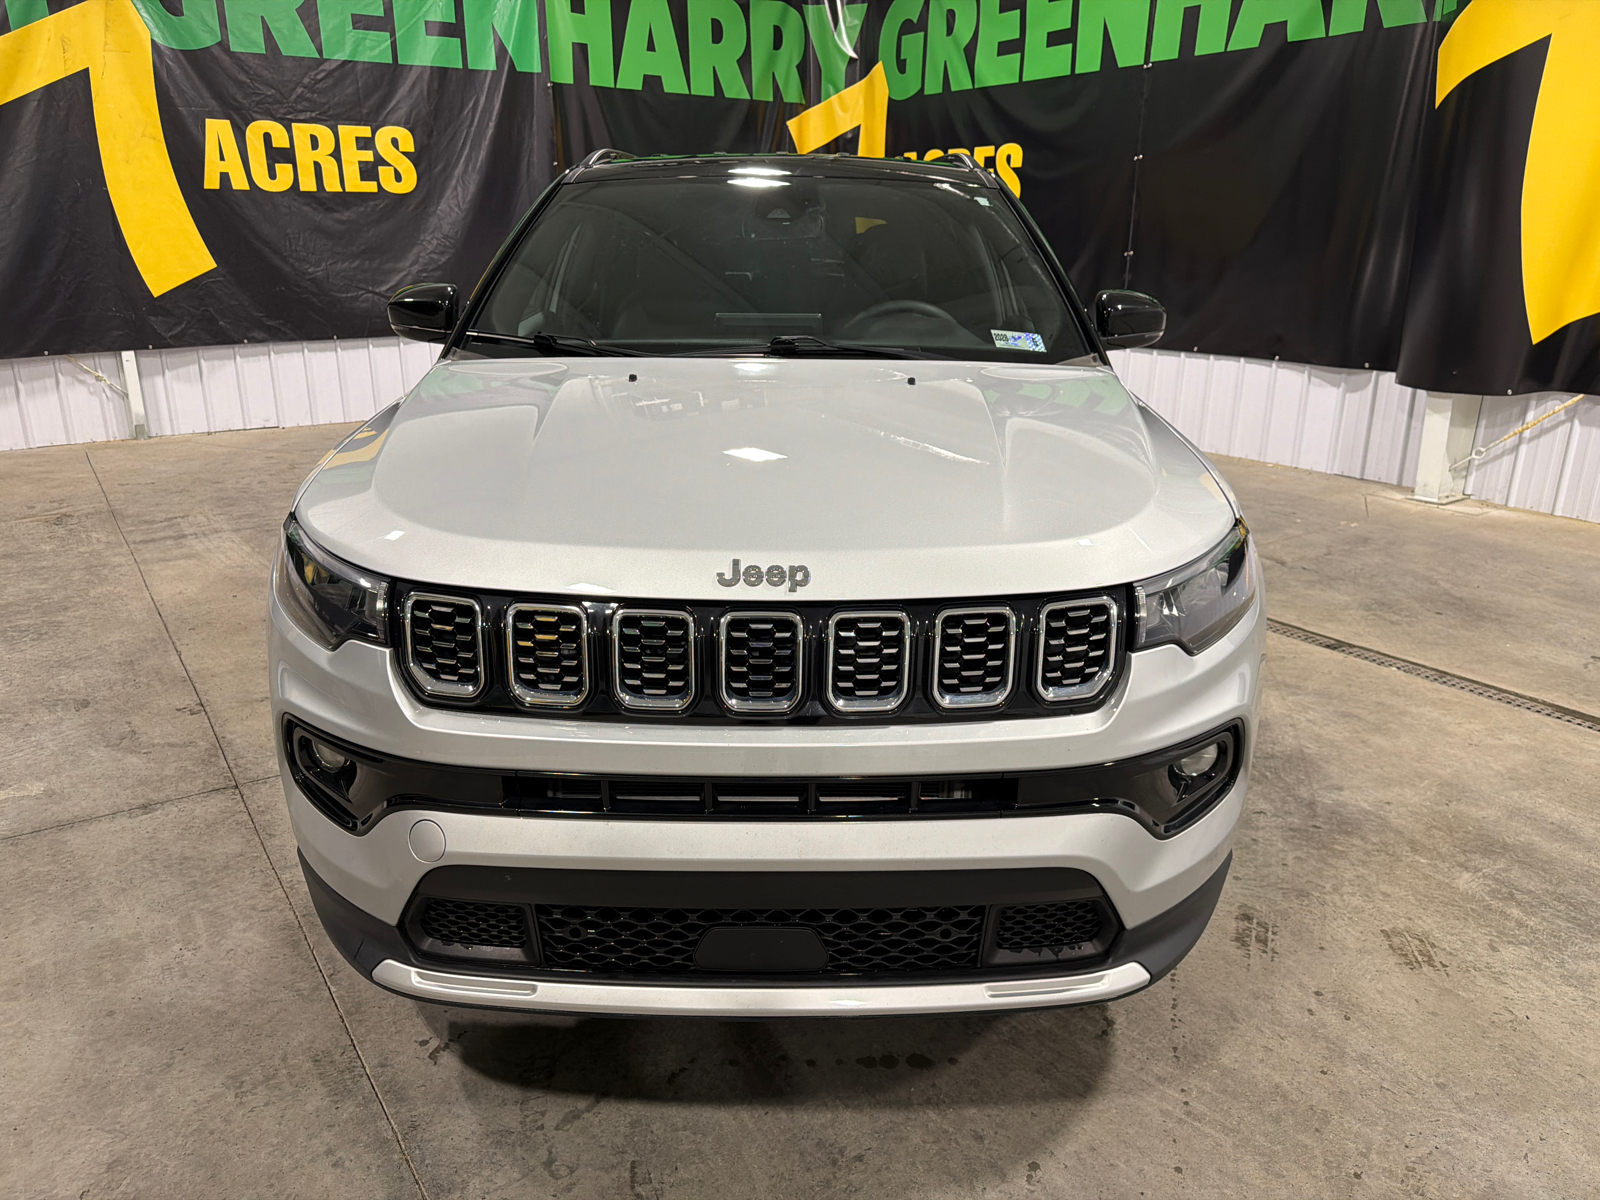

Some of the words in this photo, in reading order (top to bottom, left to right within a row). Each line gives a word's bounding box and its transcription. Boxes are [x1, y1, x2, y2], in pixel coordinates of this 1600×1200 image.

[546, 0, 868, 104] HARRY
[878, 0, 1149, 100] GREEN
[0, 0, 217, 298] 7
[203, 118, 418, 194] ACRES
[716, 558, 811, 592] Jeep
